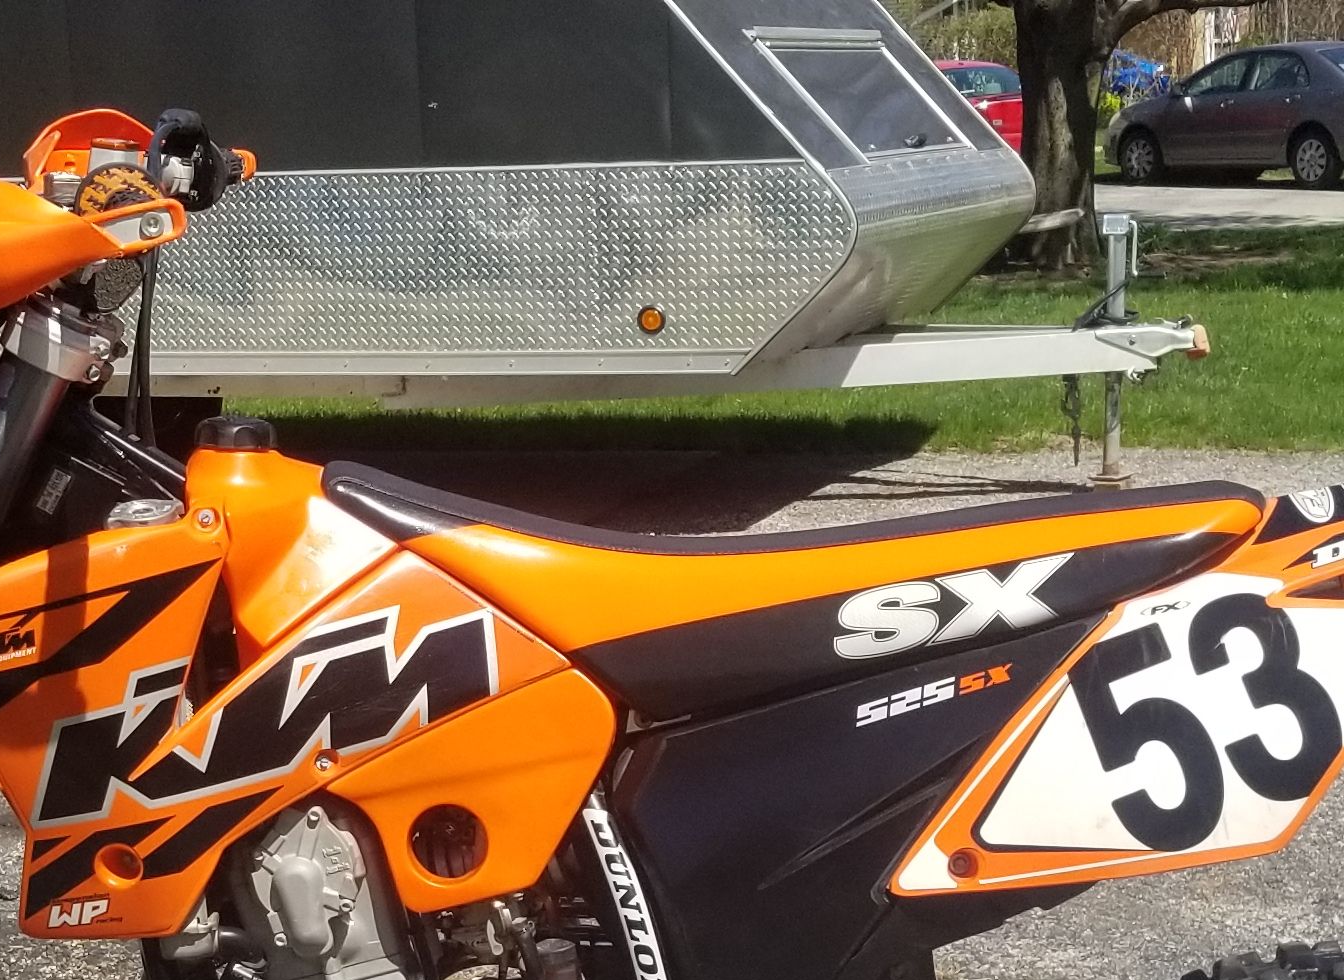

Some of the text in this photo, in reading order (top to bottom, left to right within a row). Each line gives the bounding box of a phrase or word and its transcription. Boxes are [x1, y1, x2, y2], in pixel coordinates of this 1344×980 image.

[833, 552, 1074, 659] SX
[34, 605, 499, 828] KTM
[856, 663, 1013, 727] 525 SX
[1068, 594, 1344, 852] 53
[47, 898, 110, 929] WP
